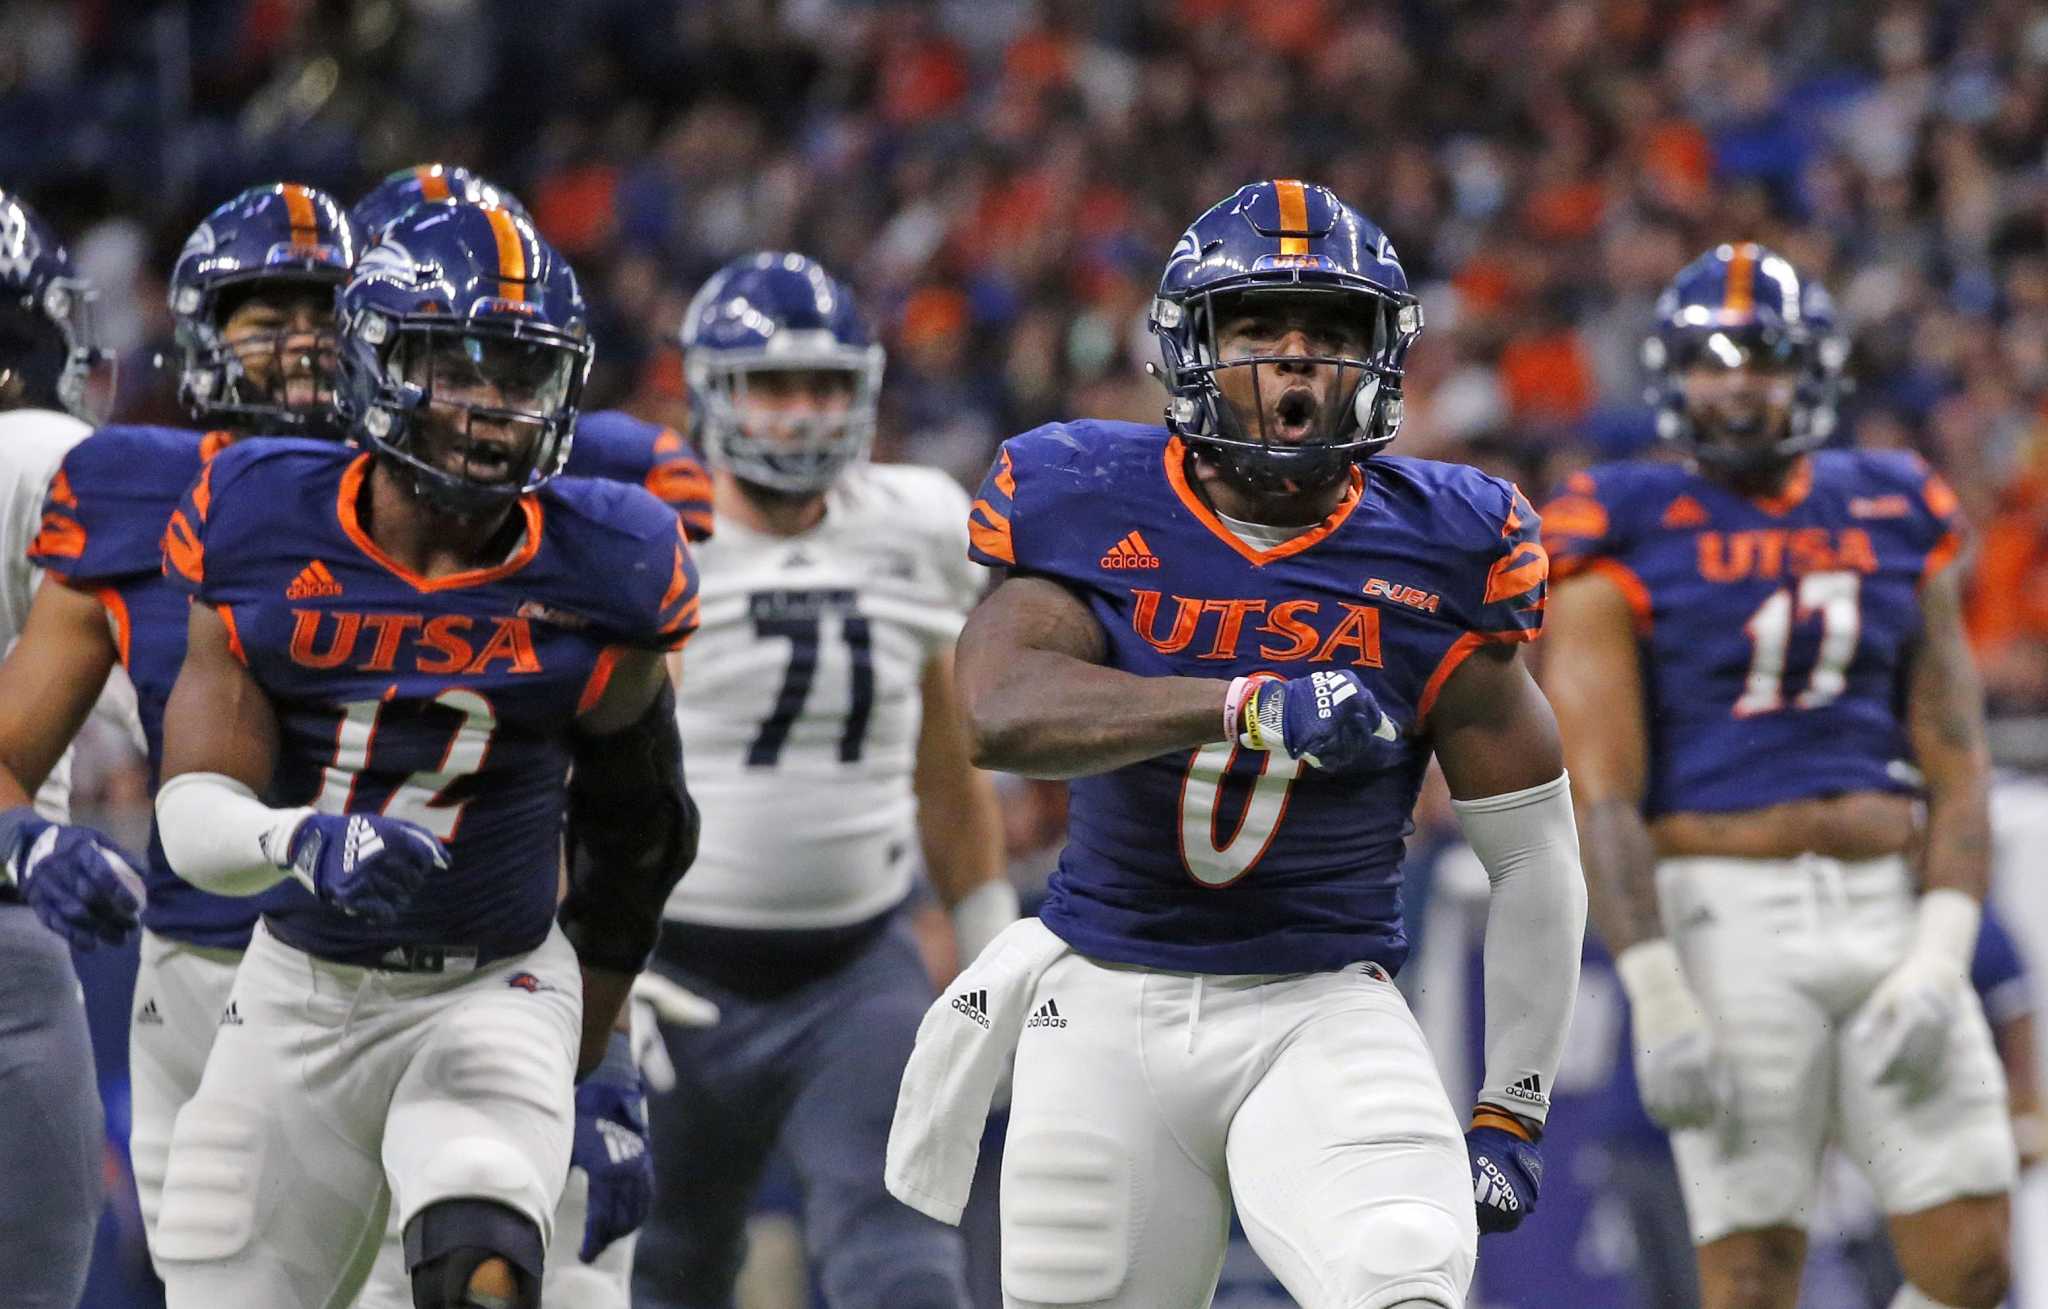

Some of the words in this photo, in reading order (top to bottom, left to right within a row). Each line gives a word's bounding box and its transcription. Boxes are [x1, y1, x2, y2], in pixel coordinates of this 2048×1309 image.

[1100, 553, 1160, 569] adidas
[1698, 528, 1878, 583] UTSA
[286, 582, 343, 600] adidas
[289, 608, 543, 675] UTSA
[1130, 588, 1384, 669] UTSA
[1732, 571, 1862, 719] 17
[747, 616, 875, 767] 71
[312, 684, 497, 844] 12
[1178, 672, 1302, 889] 0
[951, 998, 991, 1029] adidas
[1027, 1015, 1068, 1029] adidas
[1505, 1086, 1546, 1103] adidas
[1477, 1156, 1519, 1211] adidas
